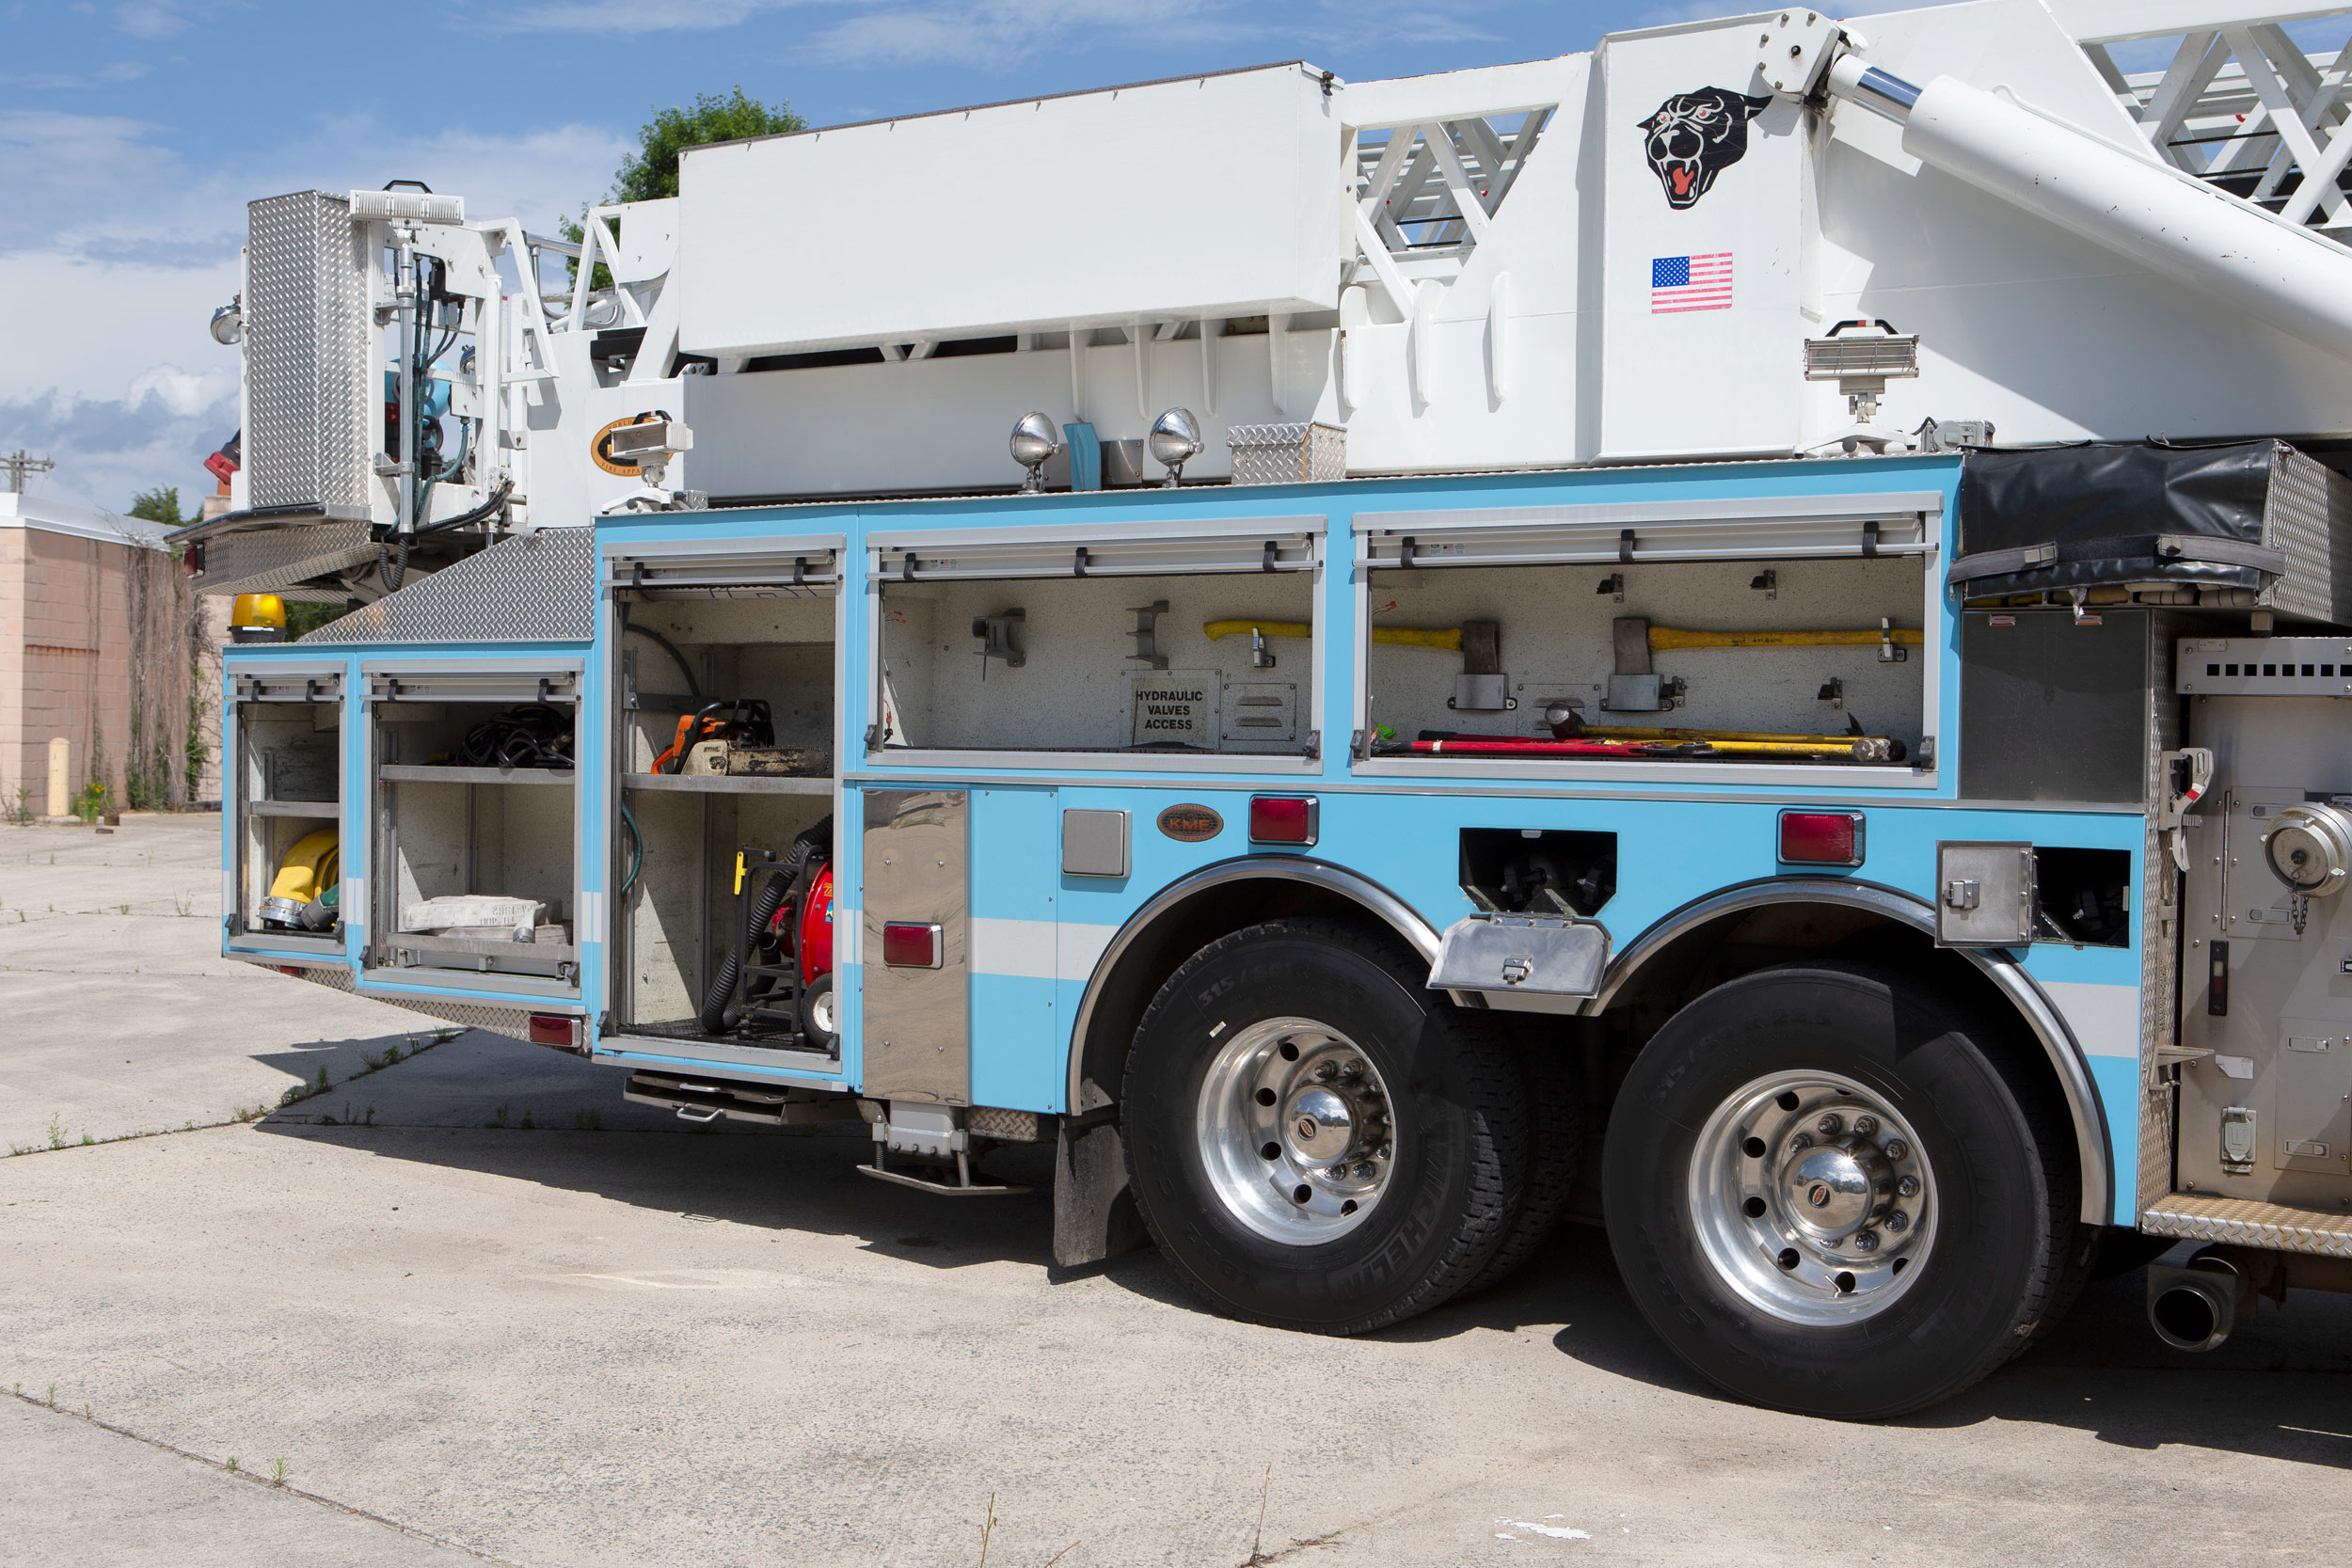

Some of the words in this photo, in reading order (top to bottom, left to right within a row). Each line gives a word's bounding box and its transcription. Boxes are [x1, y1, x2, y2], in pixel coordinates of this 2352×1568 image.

[601, 462, 617, 473] FIRE
[1136, 690, 1203, 702] HYDRAULIC
[1148, 705, 1190, 716] VALVES
[1144, 720, 1193, 730] ACCESS
[1168, 817, 1211, 832] KME
